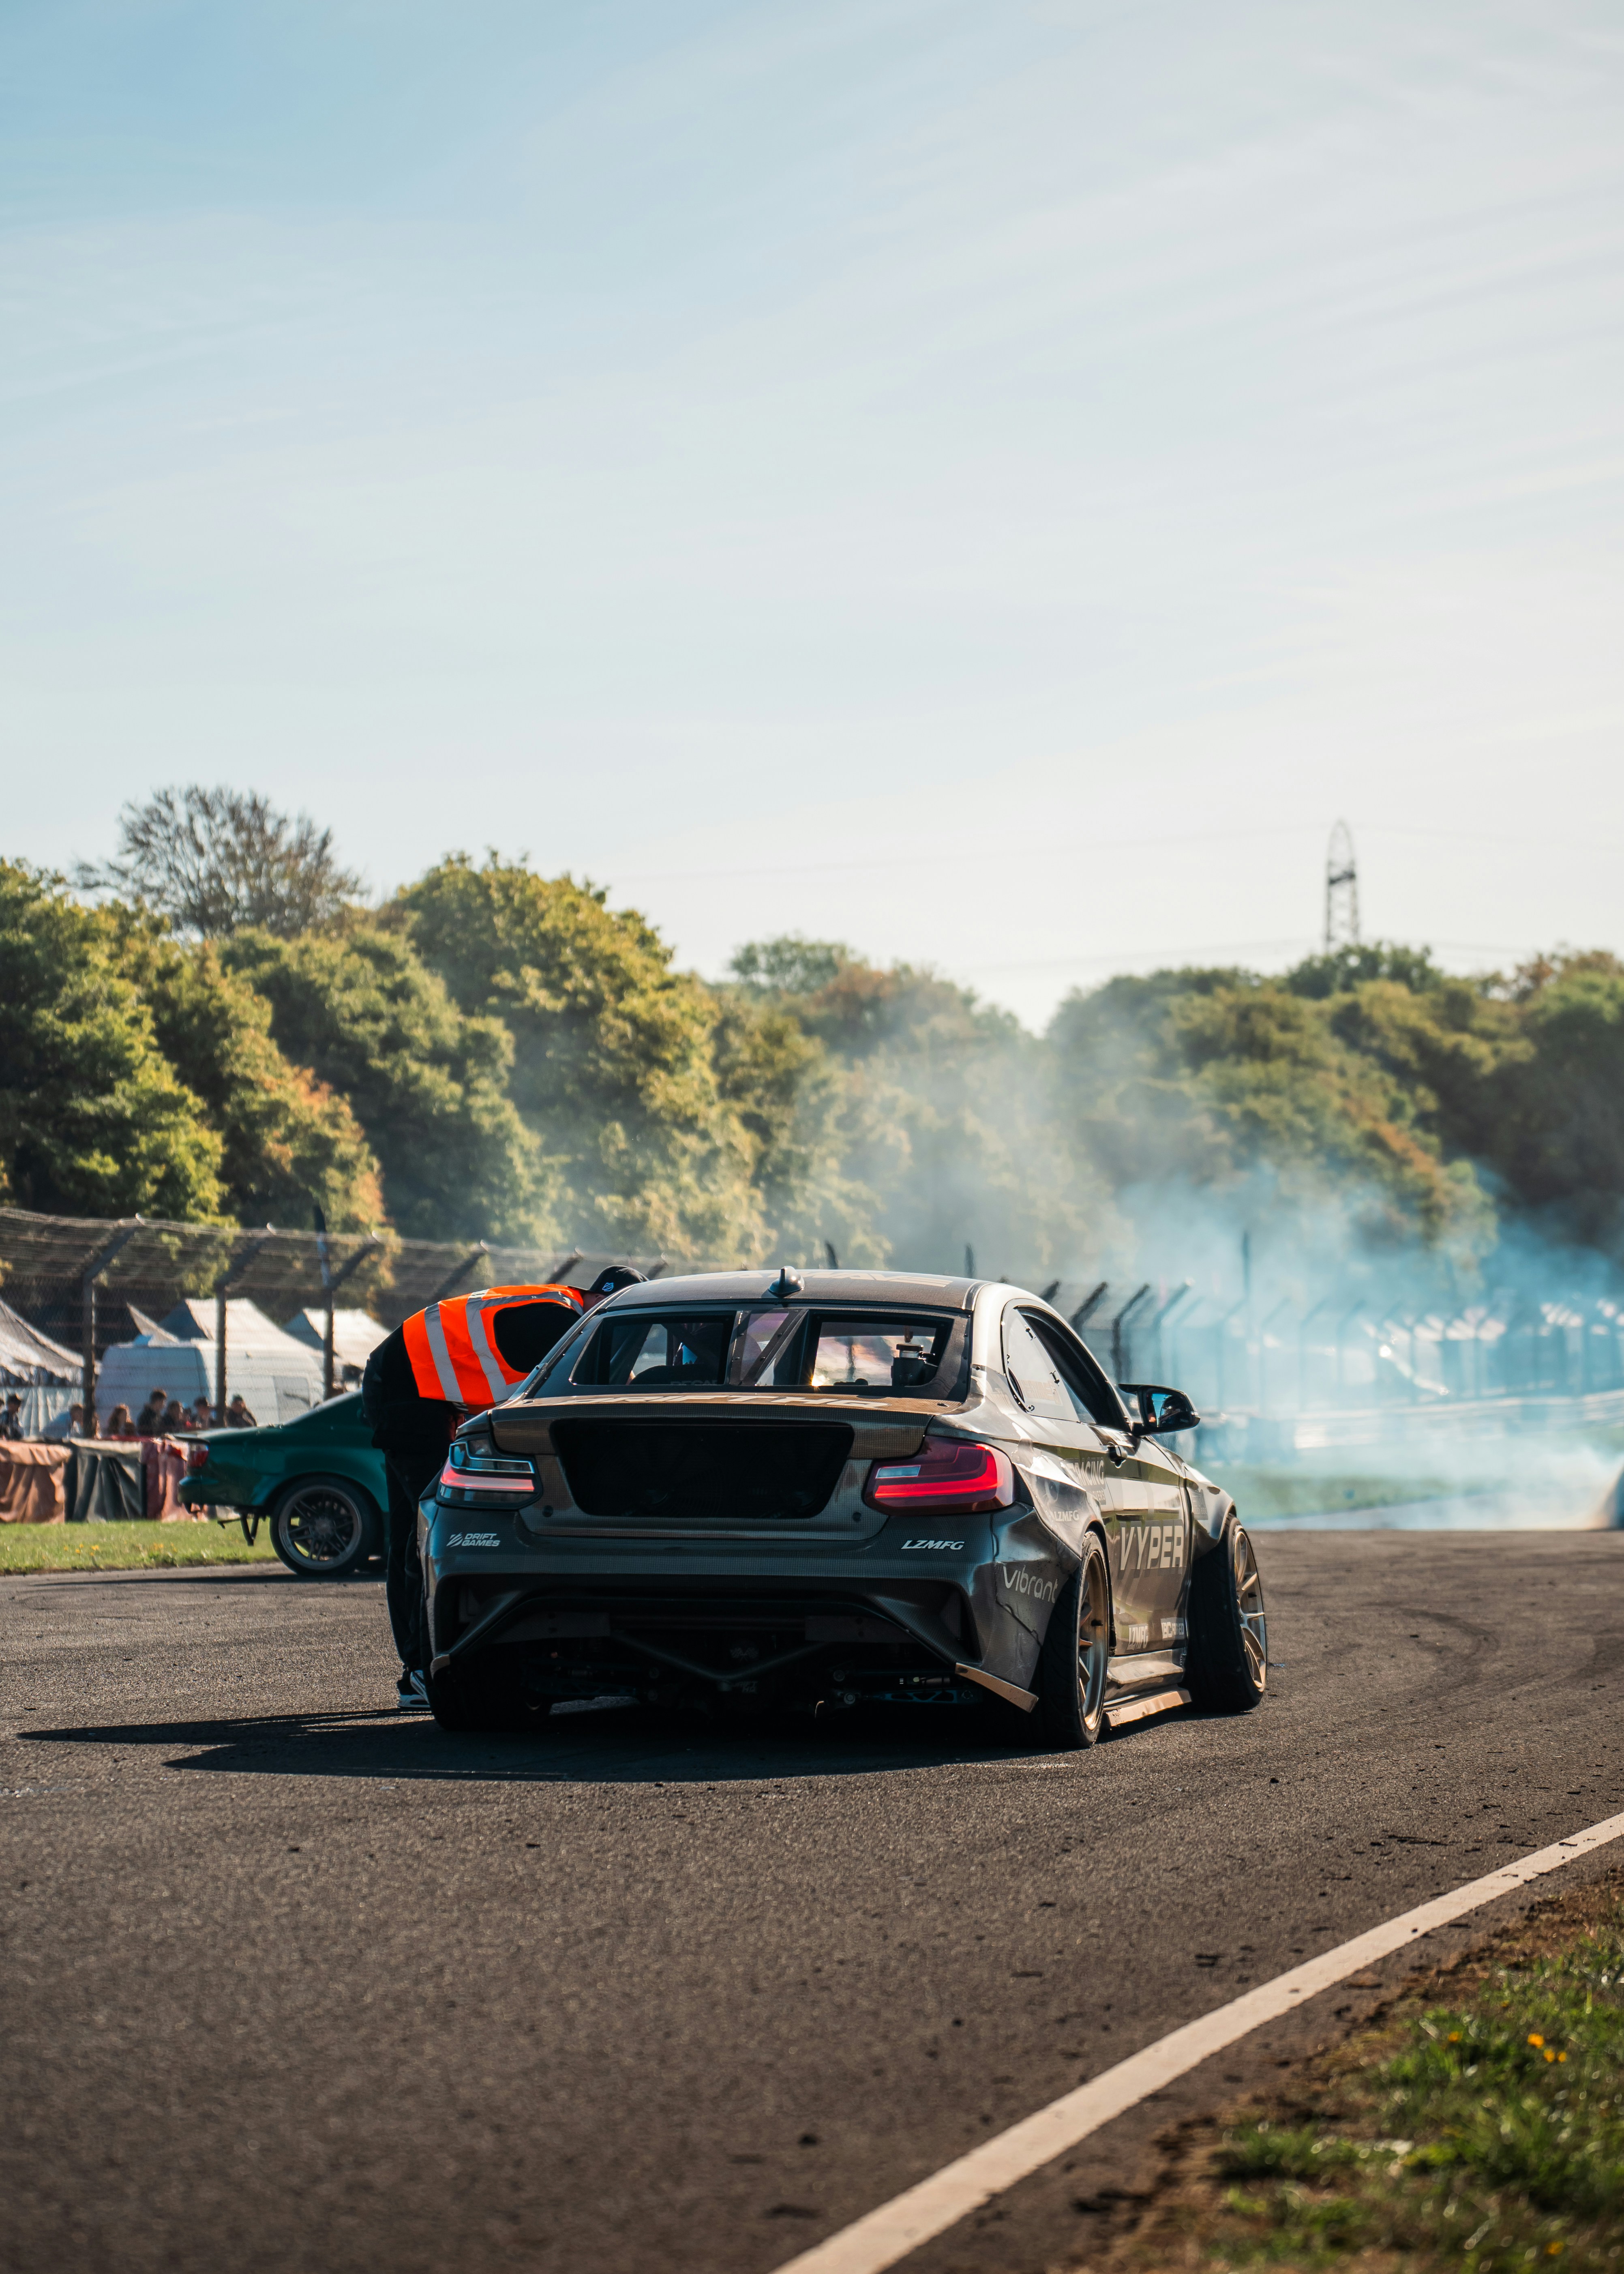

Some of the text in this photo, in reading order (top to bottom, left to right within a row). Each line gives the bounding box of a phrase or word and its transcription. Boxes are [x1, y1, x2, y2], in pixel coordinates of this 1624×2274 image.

[1054, 1510, 1079, 1521] LZMFG
[901, 1540, 965, 1550] LZMFG
[1120, 1525, 1184, 1570] VYPER
[1127, 1625, 1148, 1650] LZMFG
